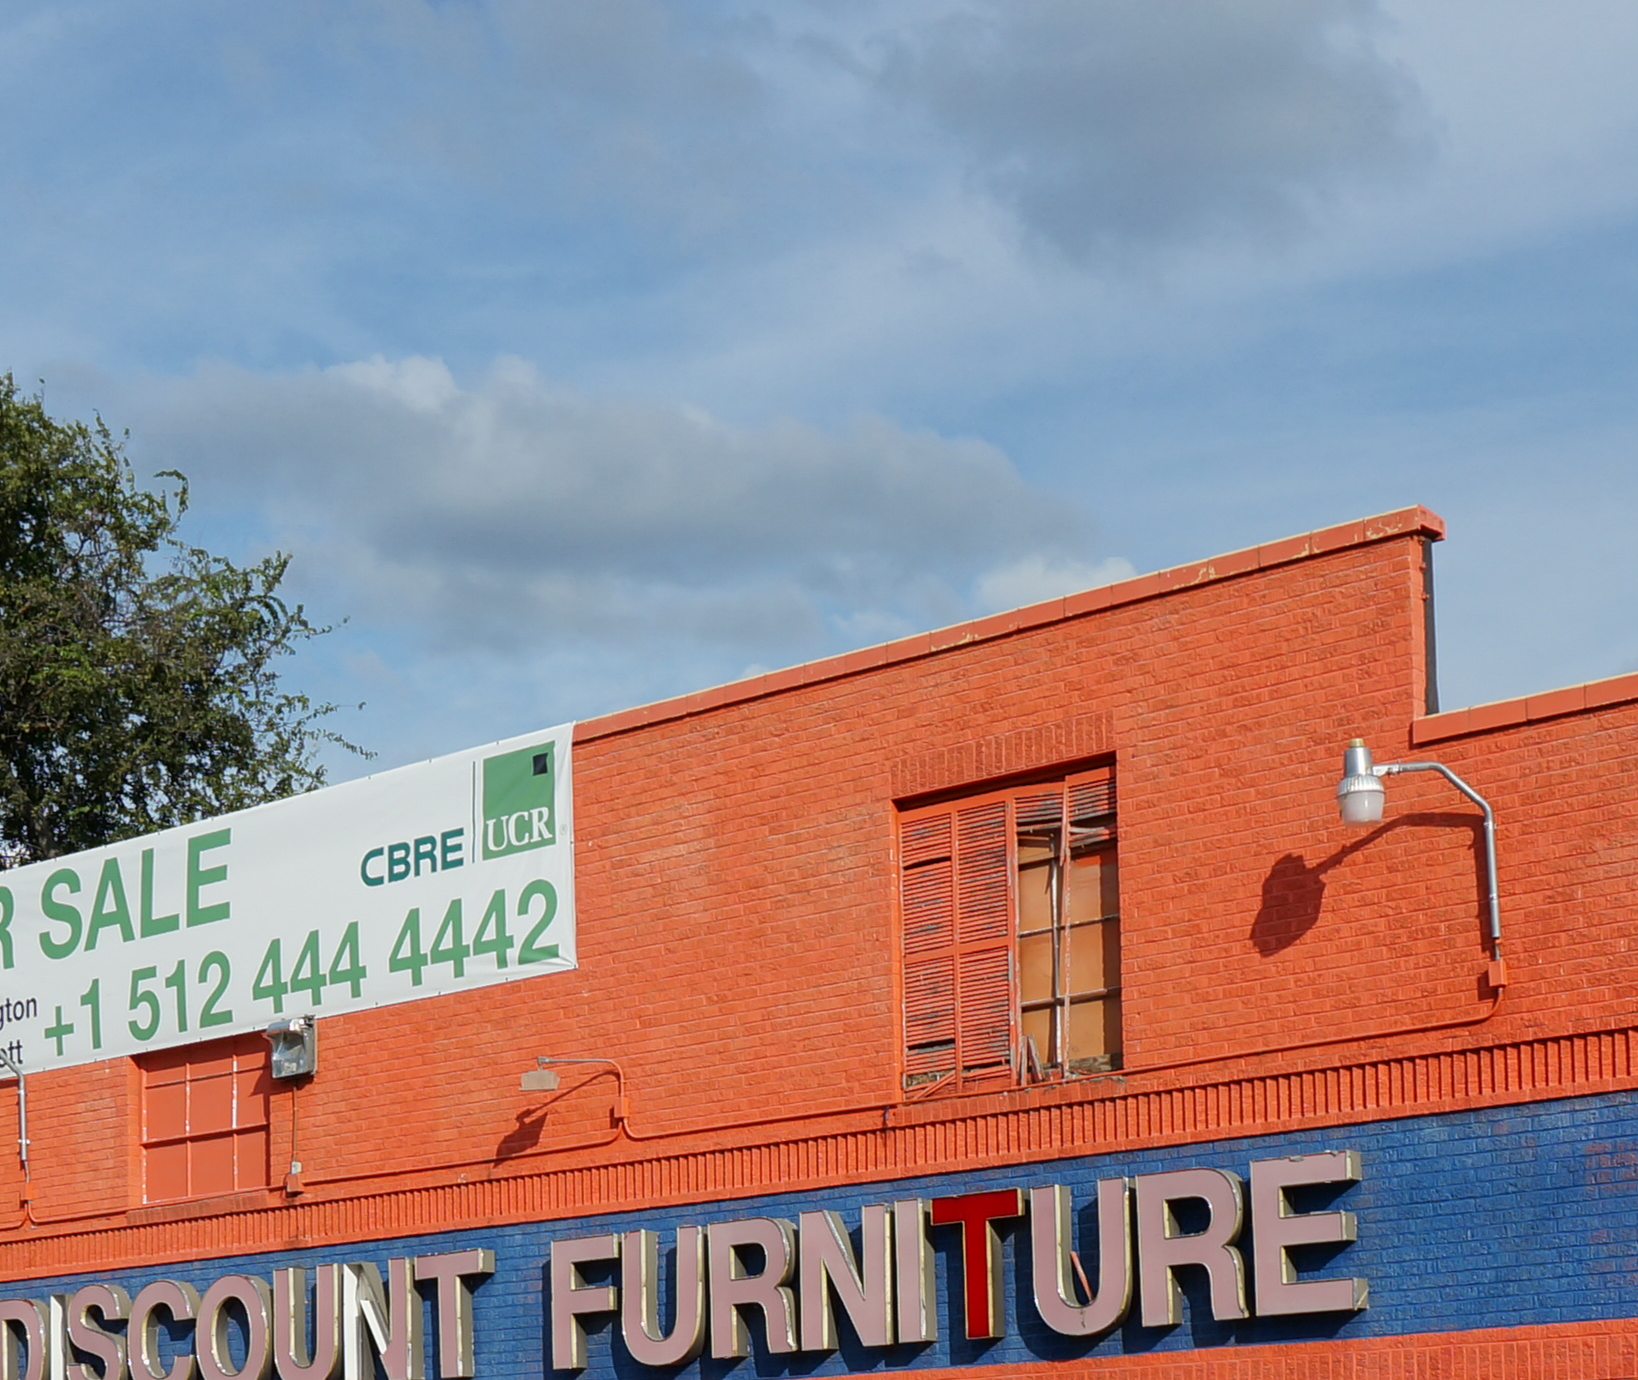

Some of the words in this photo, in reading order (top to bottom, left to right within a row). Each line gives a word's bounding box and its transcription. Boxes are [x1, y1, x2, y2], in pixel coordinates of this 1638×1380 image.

[38, 828, 232, 960] SALE
[360, 827, 465, 887] CBRE
[485, 806, 553, 851] UCR
[44, 978, 101, 1057] +1
[128, 951, 234, 1042] 512
[252, 921, 366, 1014] 444
[388, 878, 559, 987] 4442
[550, 1149, 1369, 1371] FURNITURE
